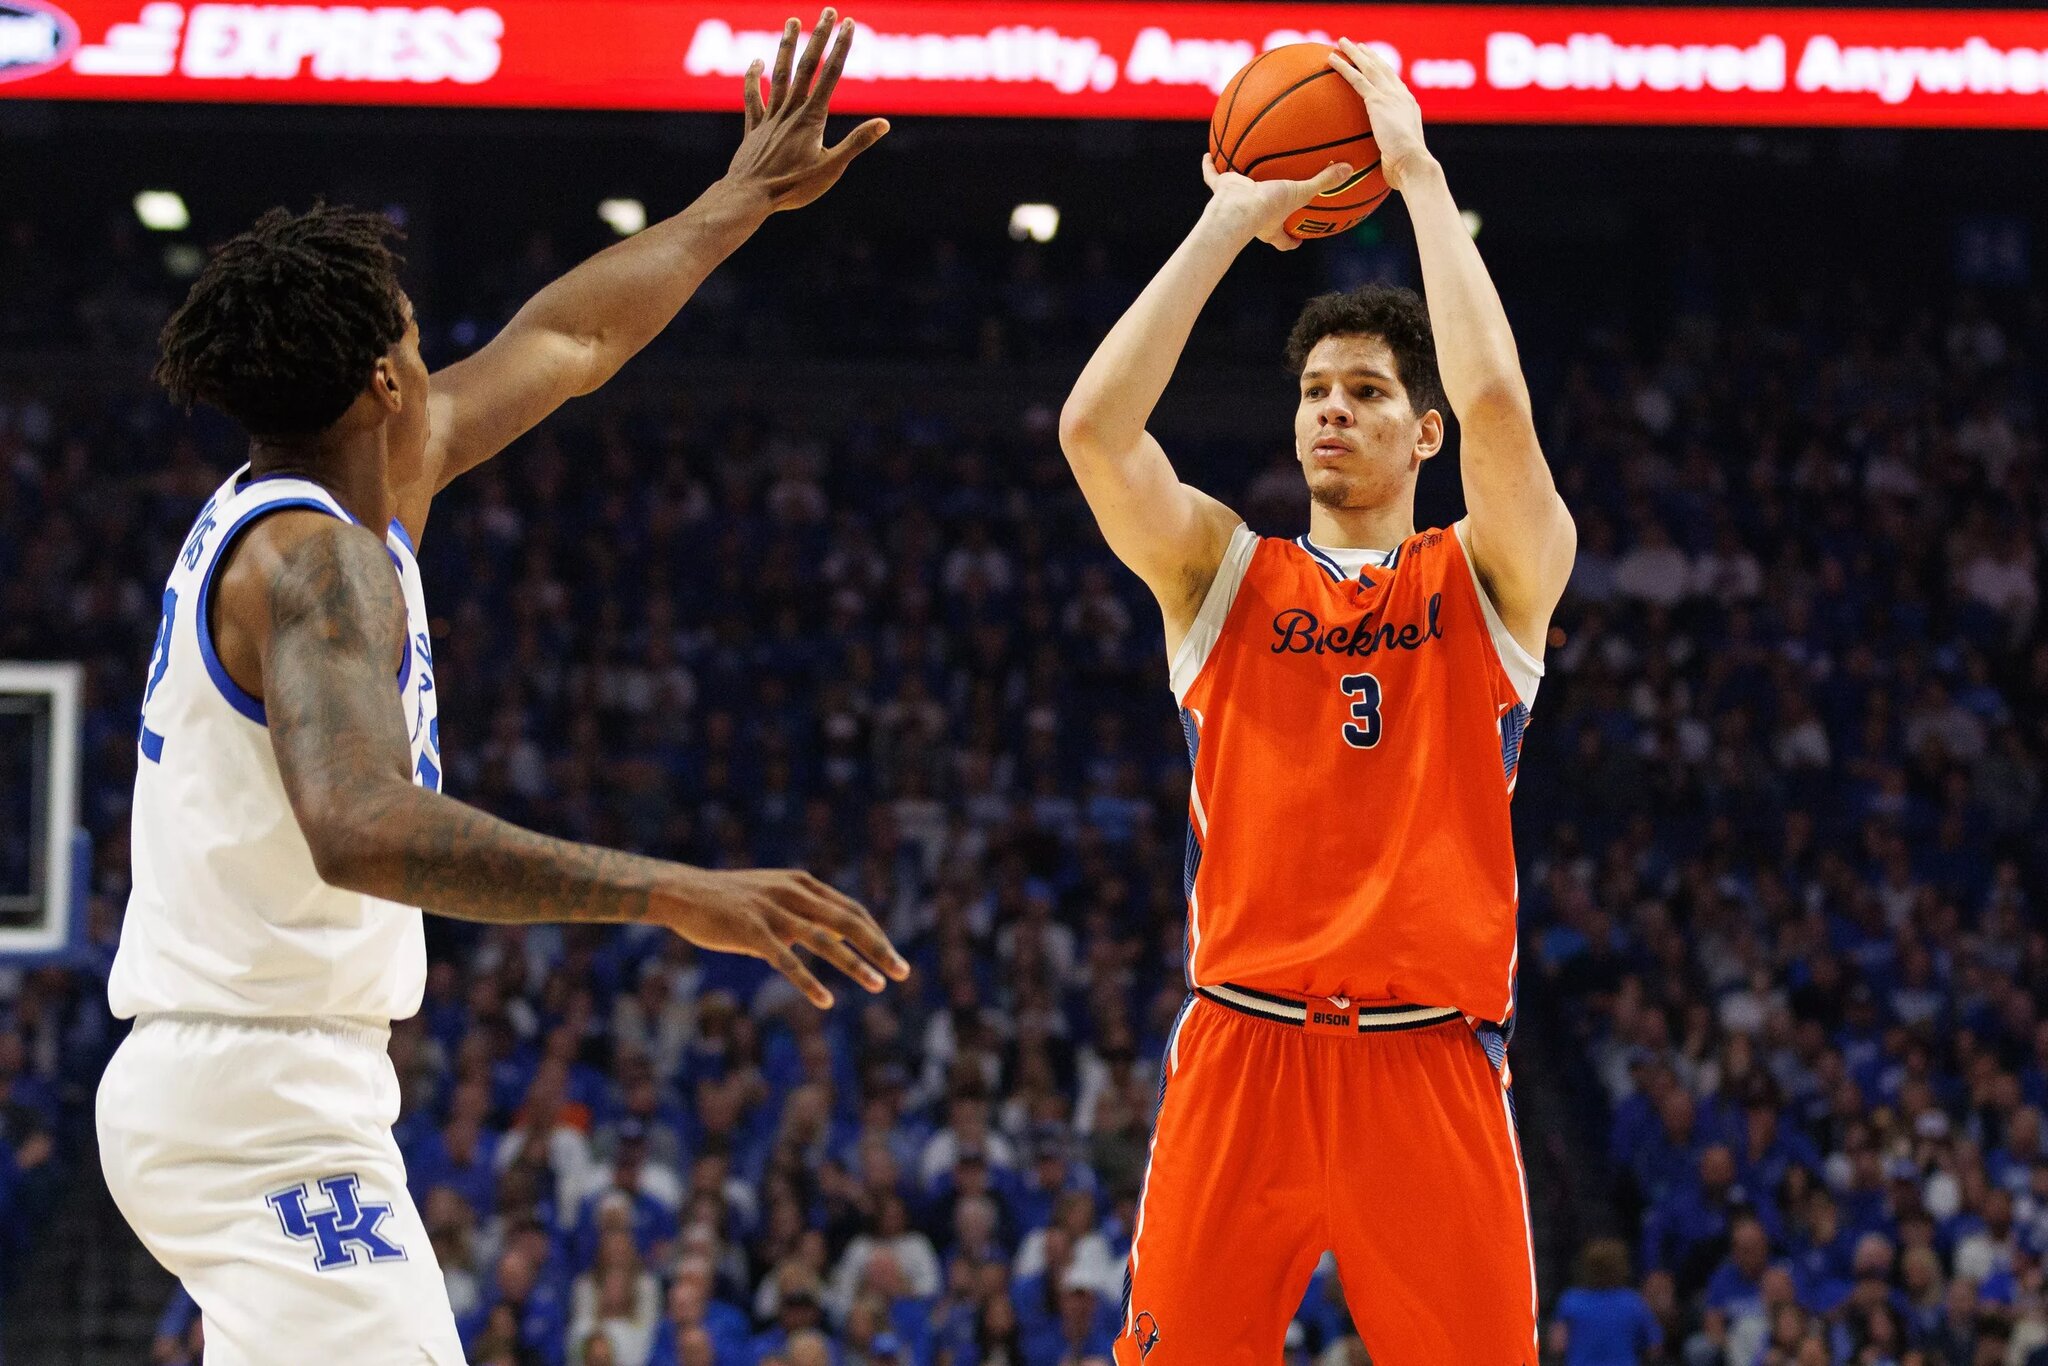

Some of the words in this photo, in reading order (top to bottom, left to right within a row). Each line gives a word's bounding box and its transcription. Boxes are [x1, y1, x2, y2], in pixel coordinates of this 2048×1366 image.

[182, 4, 503, 83] EXPRESS
[1127, 27, 1256, 96] Any
[1486, 32, 1787, 92] Delivered
[1796, 35, 2048, 104] Anywhe
[1340, 672, 1382, 750] 3
[1313, 1011, 1351, 1027] BISON
[265, 1173, 408, 1272] UK
